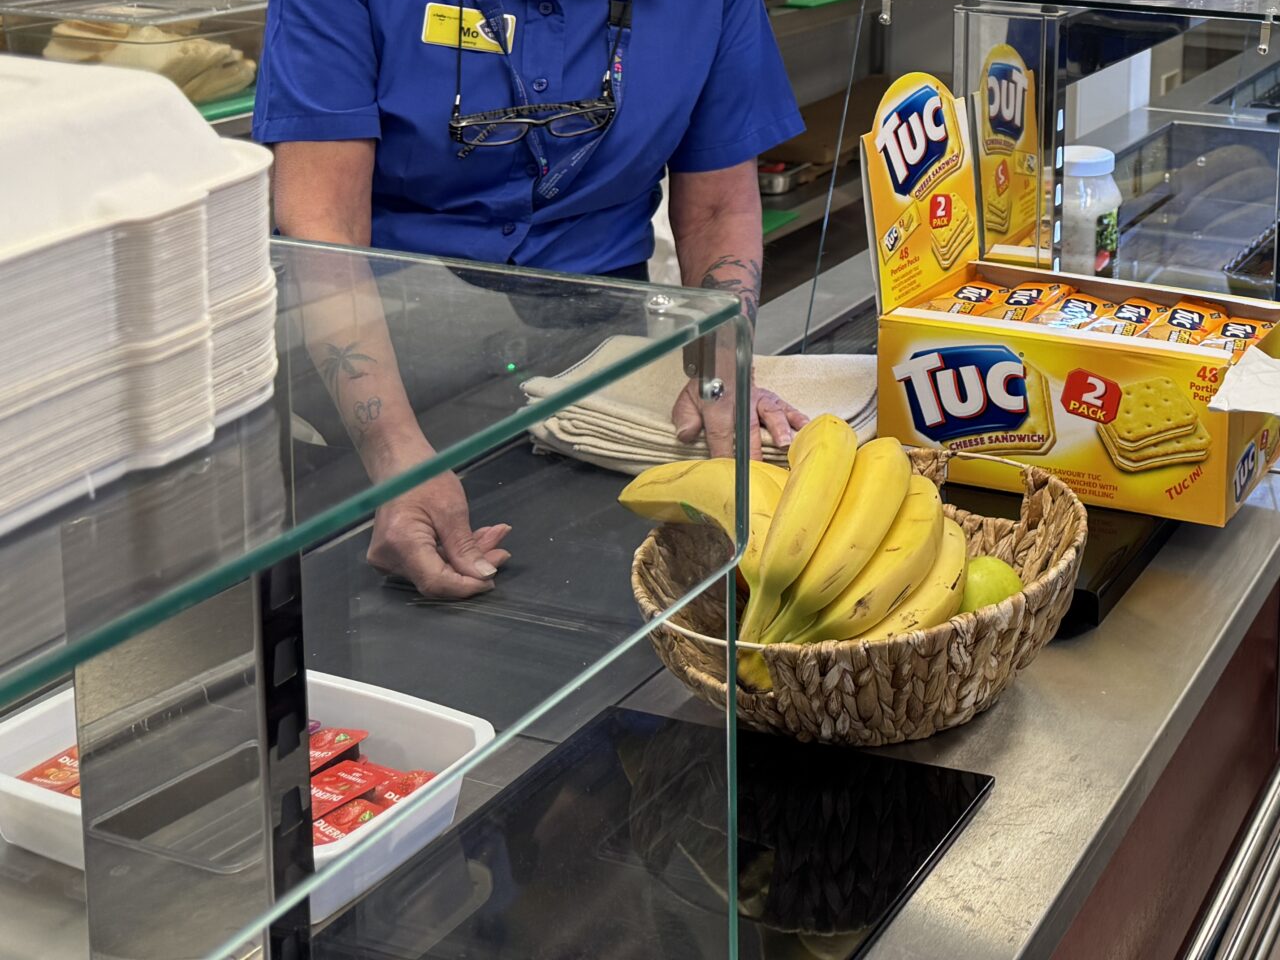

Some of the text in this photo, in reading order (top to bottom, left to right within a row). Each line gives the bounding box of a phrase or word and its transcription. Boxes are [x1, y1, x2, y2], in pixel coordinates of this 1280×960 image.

[461, 26, 479, 38] Mo
[875, 95, 948, 185] TUC
[936, 196, 946, 217] 2
[932, 217, 949, 227] PACK
[899, 246, 909, 260] 48
[957, 286, 988, 302] TUC
[1009, 289, 1038, 306] TUC
[1172, 309, 1200, 329] TUC
[1225, 323, 1253, 338] TUC
[1197, 365, 1219, 384] 48
[892, 352, 1027, 428] TUC
[1081, 376, 1107, 407] 2
[1190, 381, 1218, 395] Portio
[1193, 392, 1211, 403] Pac
[1069, 401, 1108, 422] PACK
[949, 434, 1046, 451] CHEESE SANDWICH
[1053, 468, 1086, 478] SAVOURY
[1088, 473, 1102, 481] TUC
[1060, 477, 1098, 489] NDWICHED
[1098, 483, 1118, 491] WITH
[1165, 479, 1189, 501] TUC
[1088, 489, 1114, 500] FILLING
